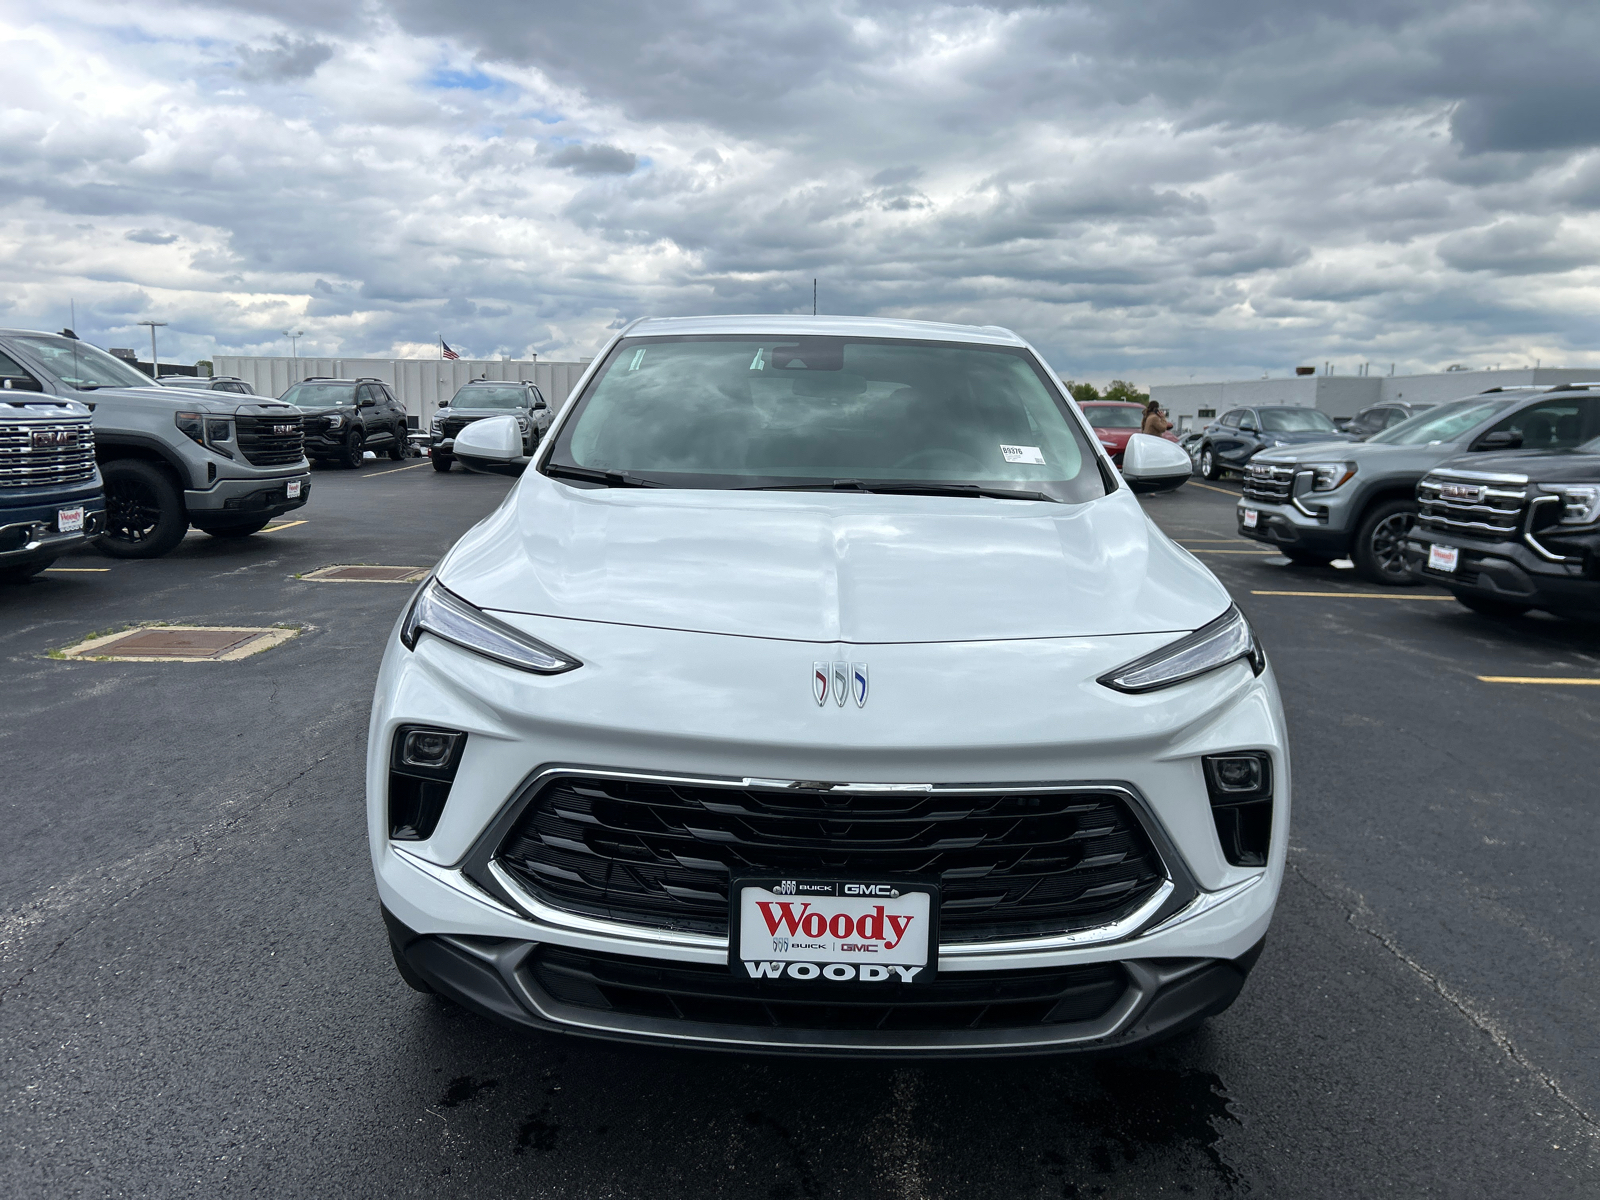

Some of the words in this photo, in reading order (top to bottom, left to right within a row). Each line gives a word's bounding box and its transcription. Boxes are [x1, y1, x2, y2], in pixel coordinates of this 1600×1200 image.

[799, 884, 833, 892] BUICK
[844, 884, 891, 895] GMC
[755, 901, 915, 950] Woody
[840, 943, 879, 953] GMC
[743, 961, 924, 983] WOODY
